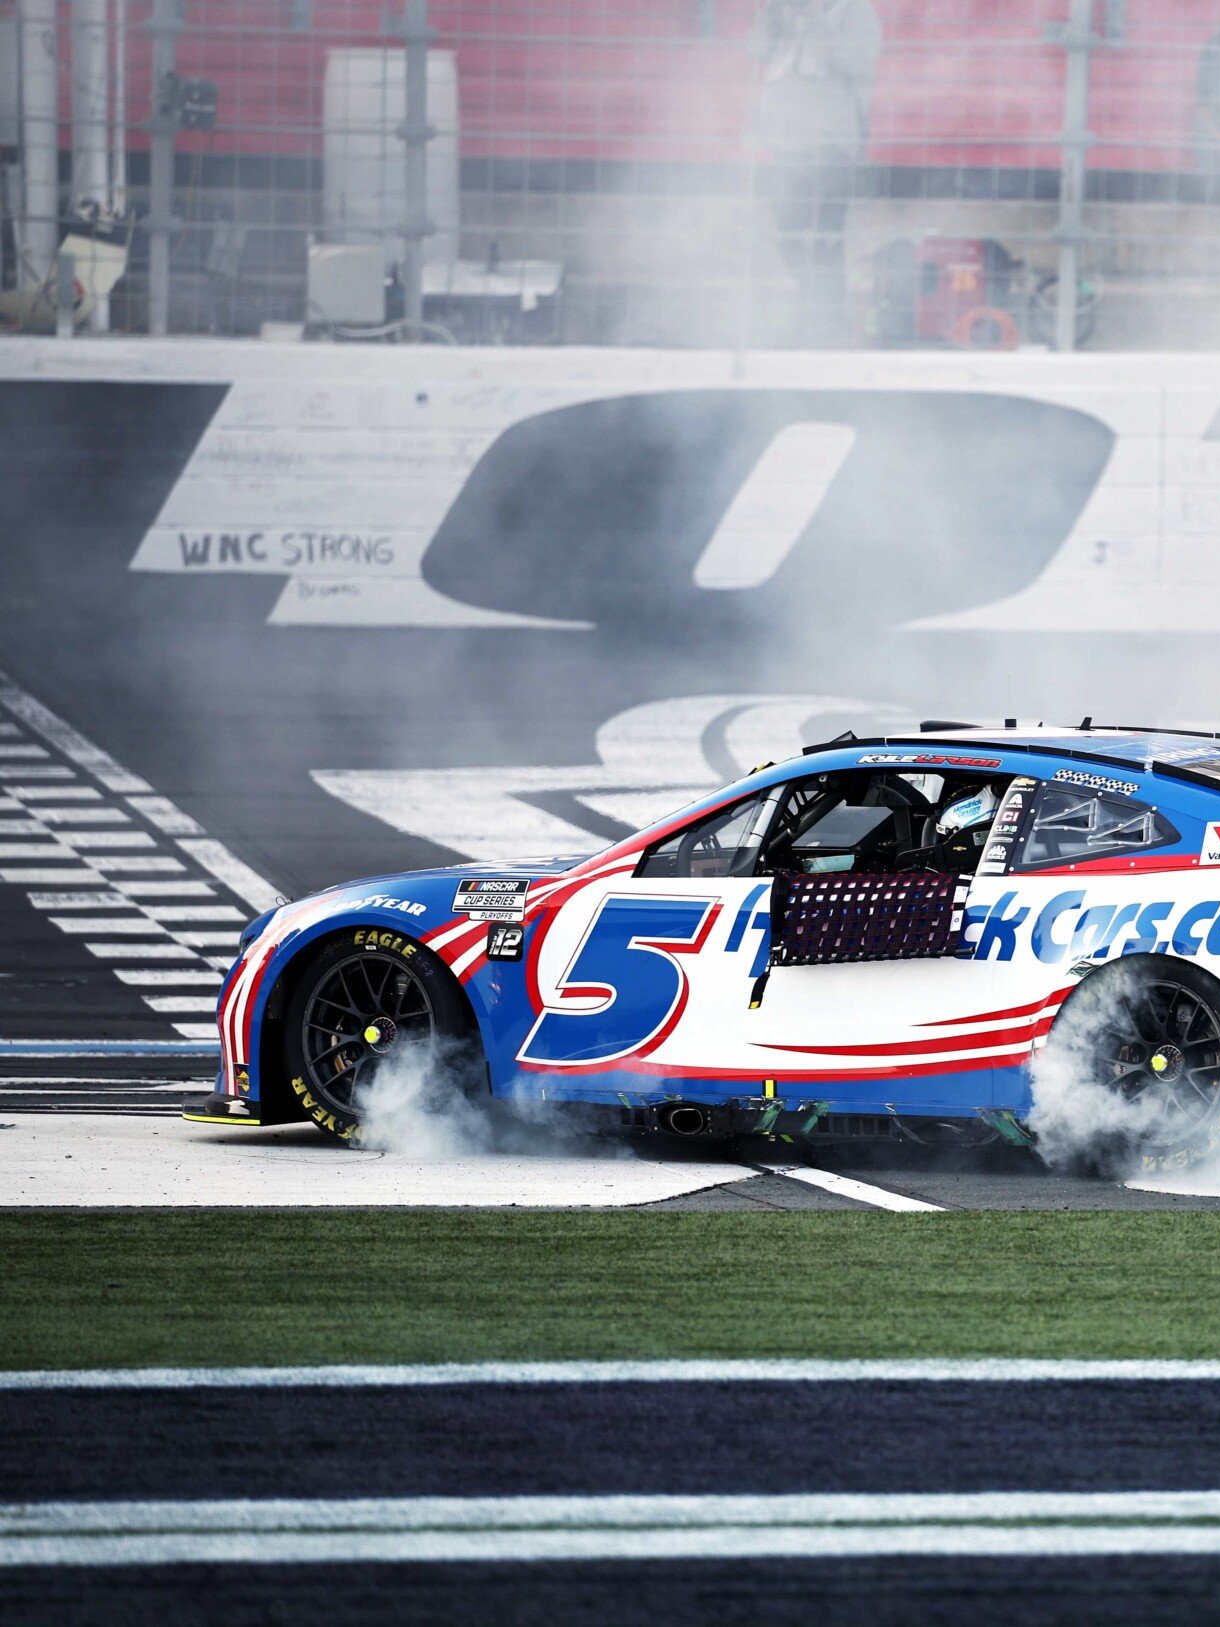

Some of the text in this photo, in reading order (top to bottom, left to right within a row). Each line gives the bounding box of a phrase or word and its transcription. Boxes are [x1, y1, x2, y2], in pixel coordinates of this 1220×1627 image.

[179, 532, 395, 567] WNC STRONG
[464, 896, 516, 905] CUP SERIES
[480, 882, 519, 891] NASCAR
[354, 930, 417, 958] EAGLE
[490, 928, 523, 956] 12
[515, 893, 723, 1067] 5
